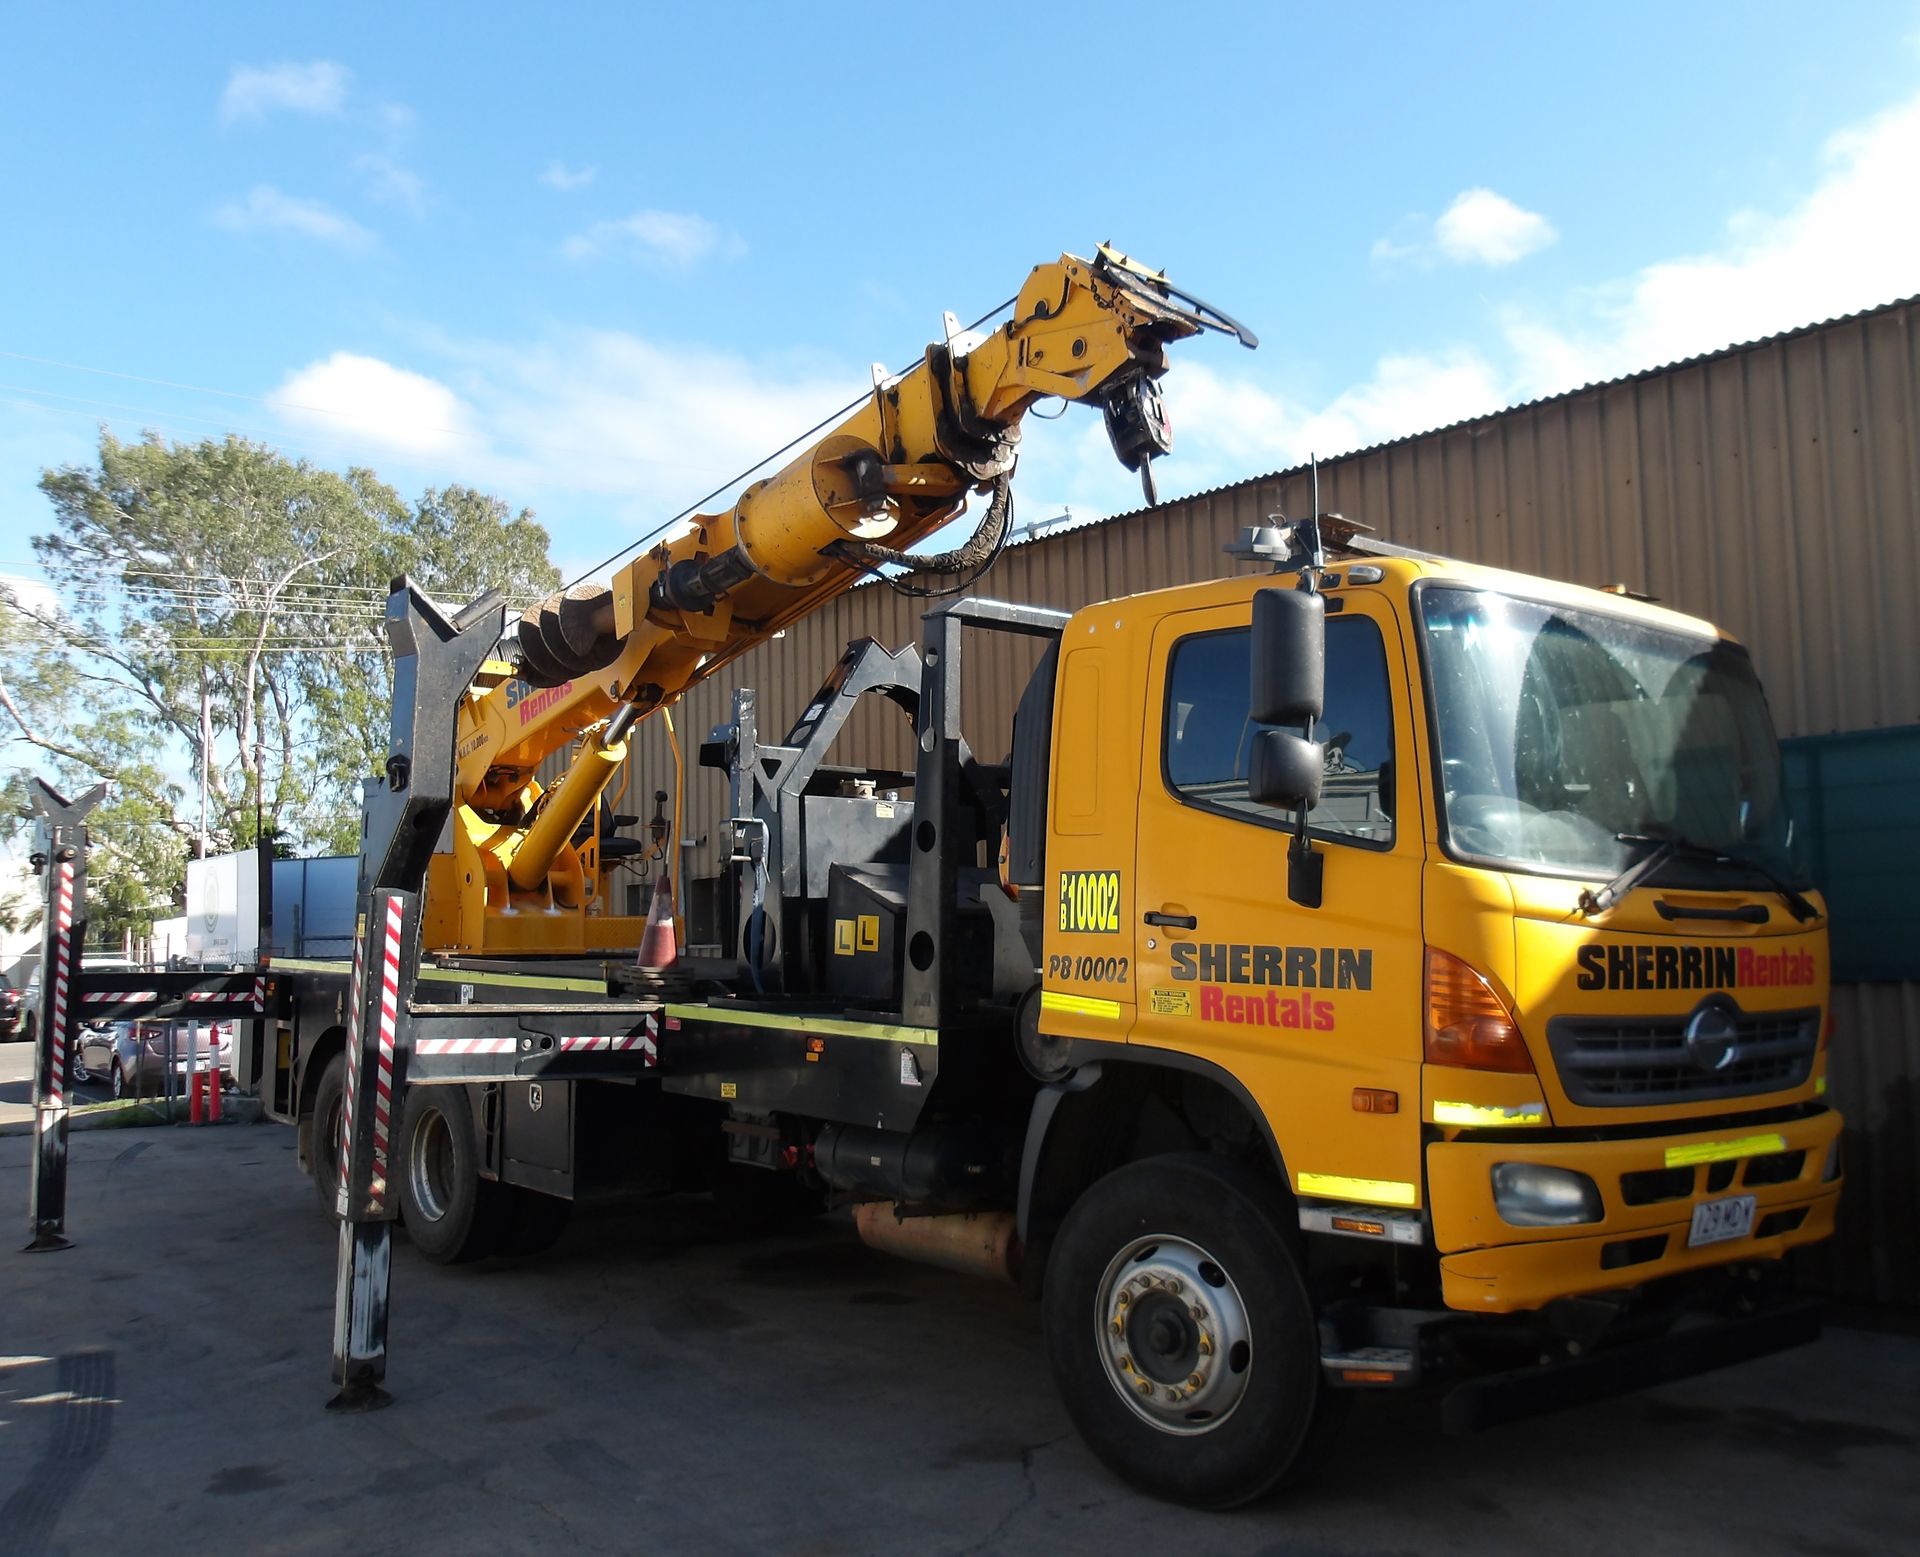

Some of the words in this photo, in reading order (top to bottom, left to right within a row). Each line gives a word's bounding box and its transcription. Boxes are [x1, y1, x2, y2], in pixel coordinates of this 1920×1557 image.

[519, 680, 573, 726] Rentals
[1068, 872, 1119, 931] 10002
[840, 925, 850, 950] L
[862, 920, 874, 946] L
[1048, 954, 1073, 980] PB
[1074, 955, 1129, 984] 10002
[1170, 942, 1373, 991] SHERRIN
[1577, 944, 1736, 991] SHERRIN
[1737, 947, 1815, 987] Rentals
[1200, 984, 1335, 1031] Rentals
